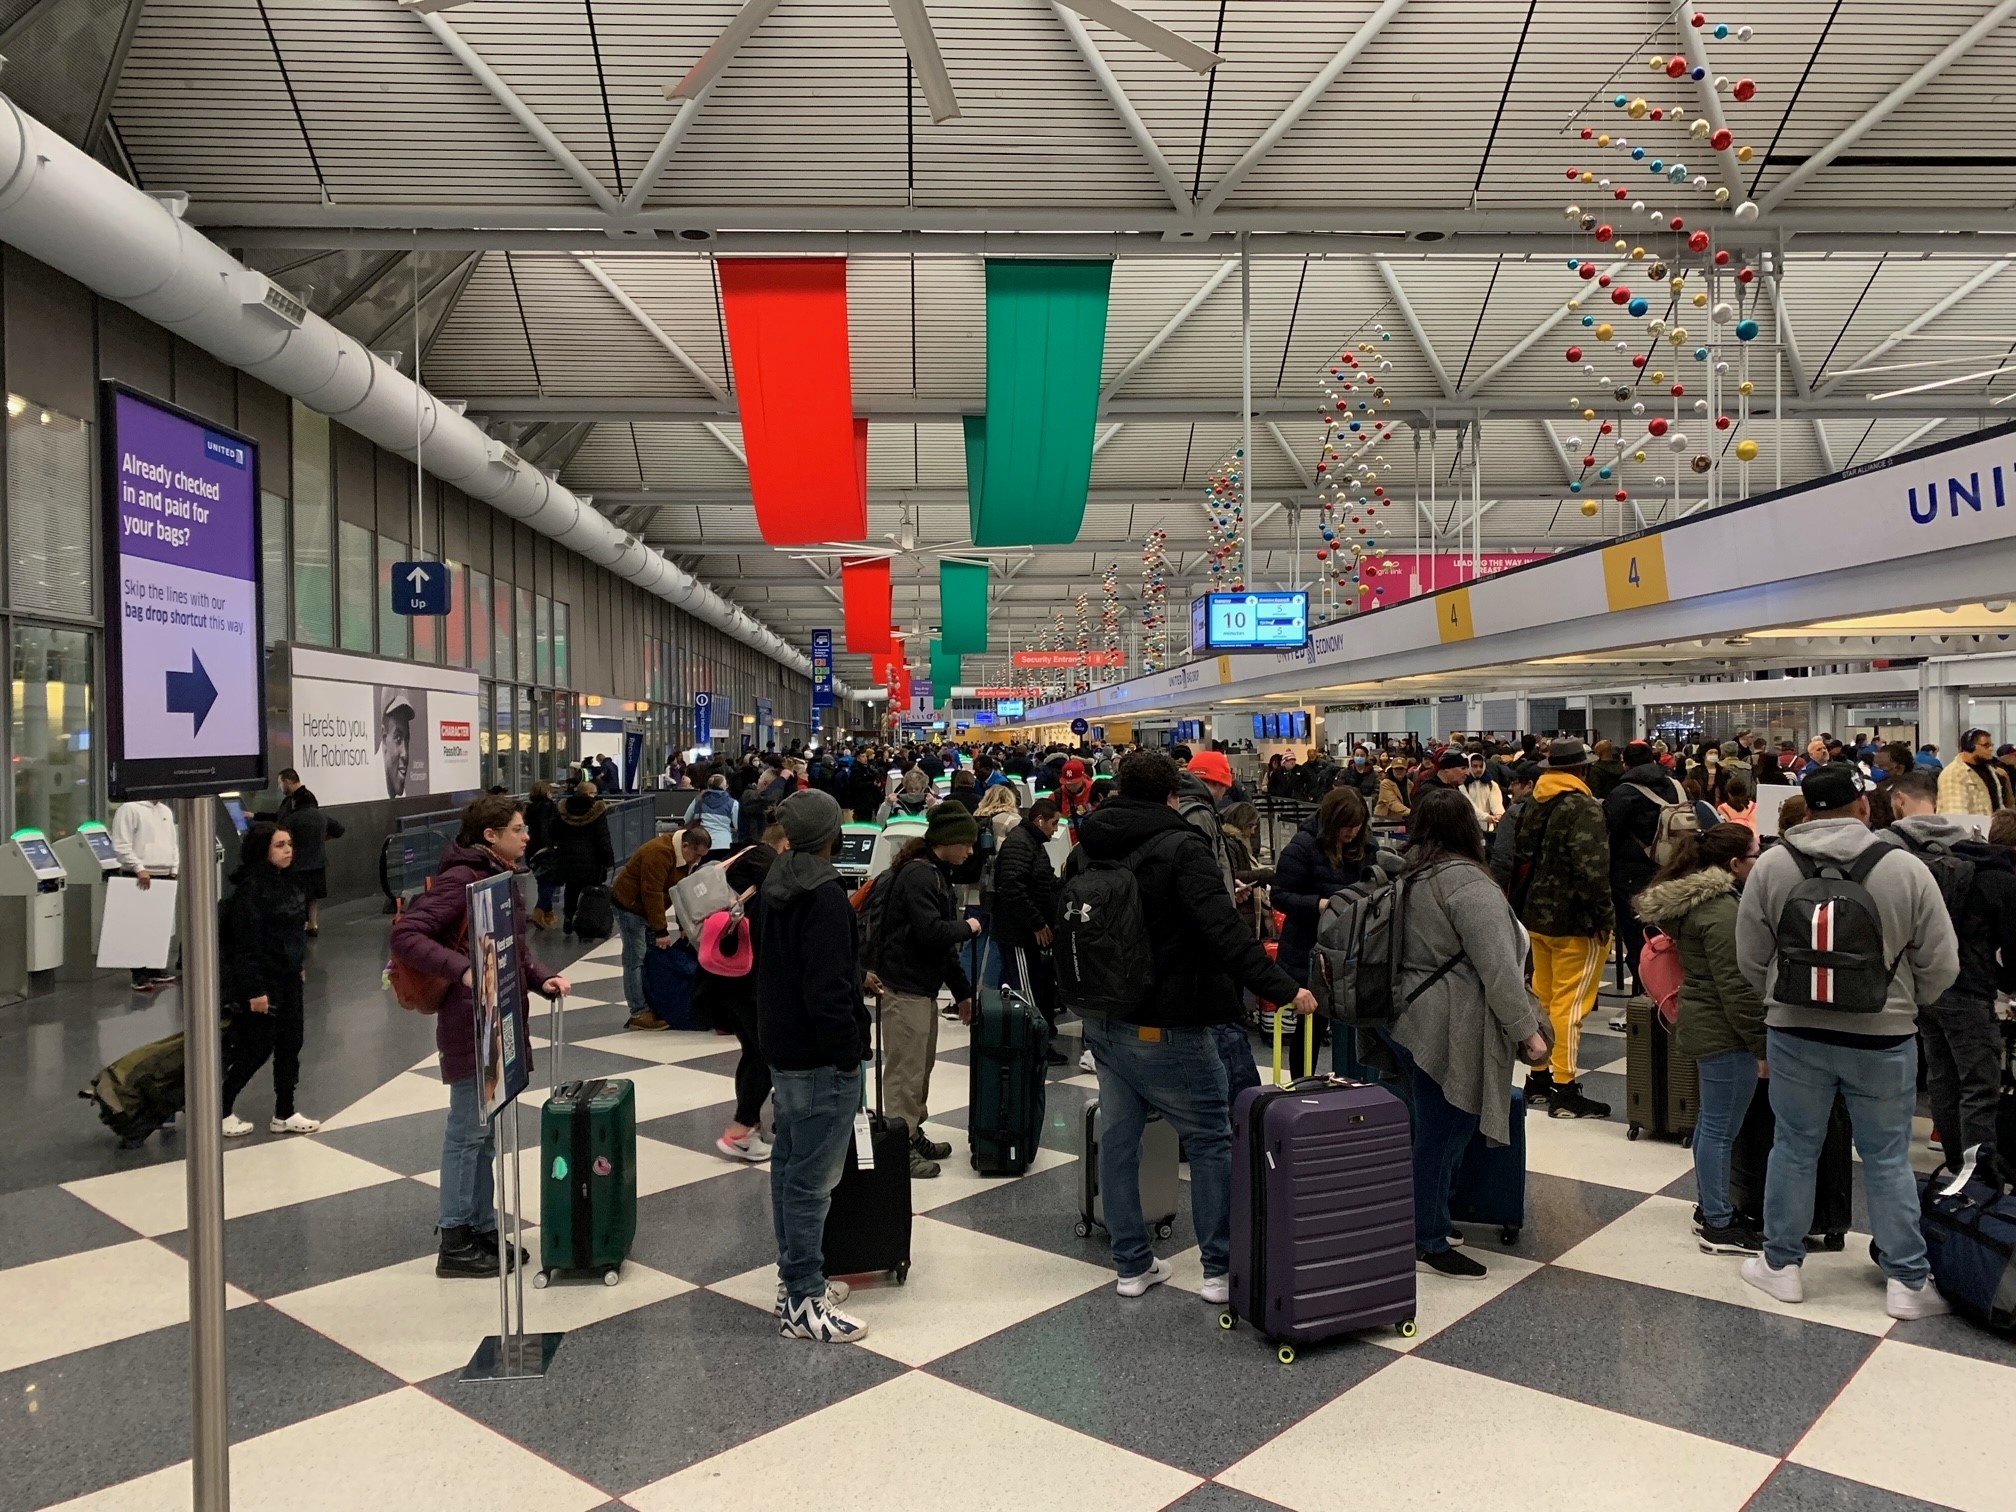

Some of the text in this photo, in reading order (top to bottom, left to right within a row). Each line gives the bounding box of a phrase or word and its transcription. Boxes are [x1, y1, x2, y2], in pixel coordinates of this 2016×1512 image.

[207, 440, 235, 458] UNITED
[122, 452, 220, 501] Already checked
[1842, 460, 1887, 479] STAR ALLIANCE
[123, 480, 210, 524] in and paid for
[1908, 462, 2016, 524] UNI
[123, 515, 191, 547] your bags?
[1453, 559, 1488, 567] LEADG
[1489, 559, 1503, 567] THE
[1505, 559, 1521, 567] WAY
[1479, 566, 1501, 574] REAST
[1628, 557, 1640, 588] 4
[124, 579, 226, 610] Skip the lines with our
[411, 599, 426, 610] Up
[125, 601, 246, 636] bag drop shortcut this way.
[1223, 611, 1246, 628] 10
[1450, 603, 1458, 627] 4
[1316, 634, 1344, 655] ECONOMY
[1021, 656, 1051, 665] Security
[303, 713, 368, 742] Here's to you,
[441, 725, 469, 737] CHARACTER
[303, 744, 369, 768] Mr. Robinson.
[1072, 954, 1081, 982] ARMOUR
